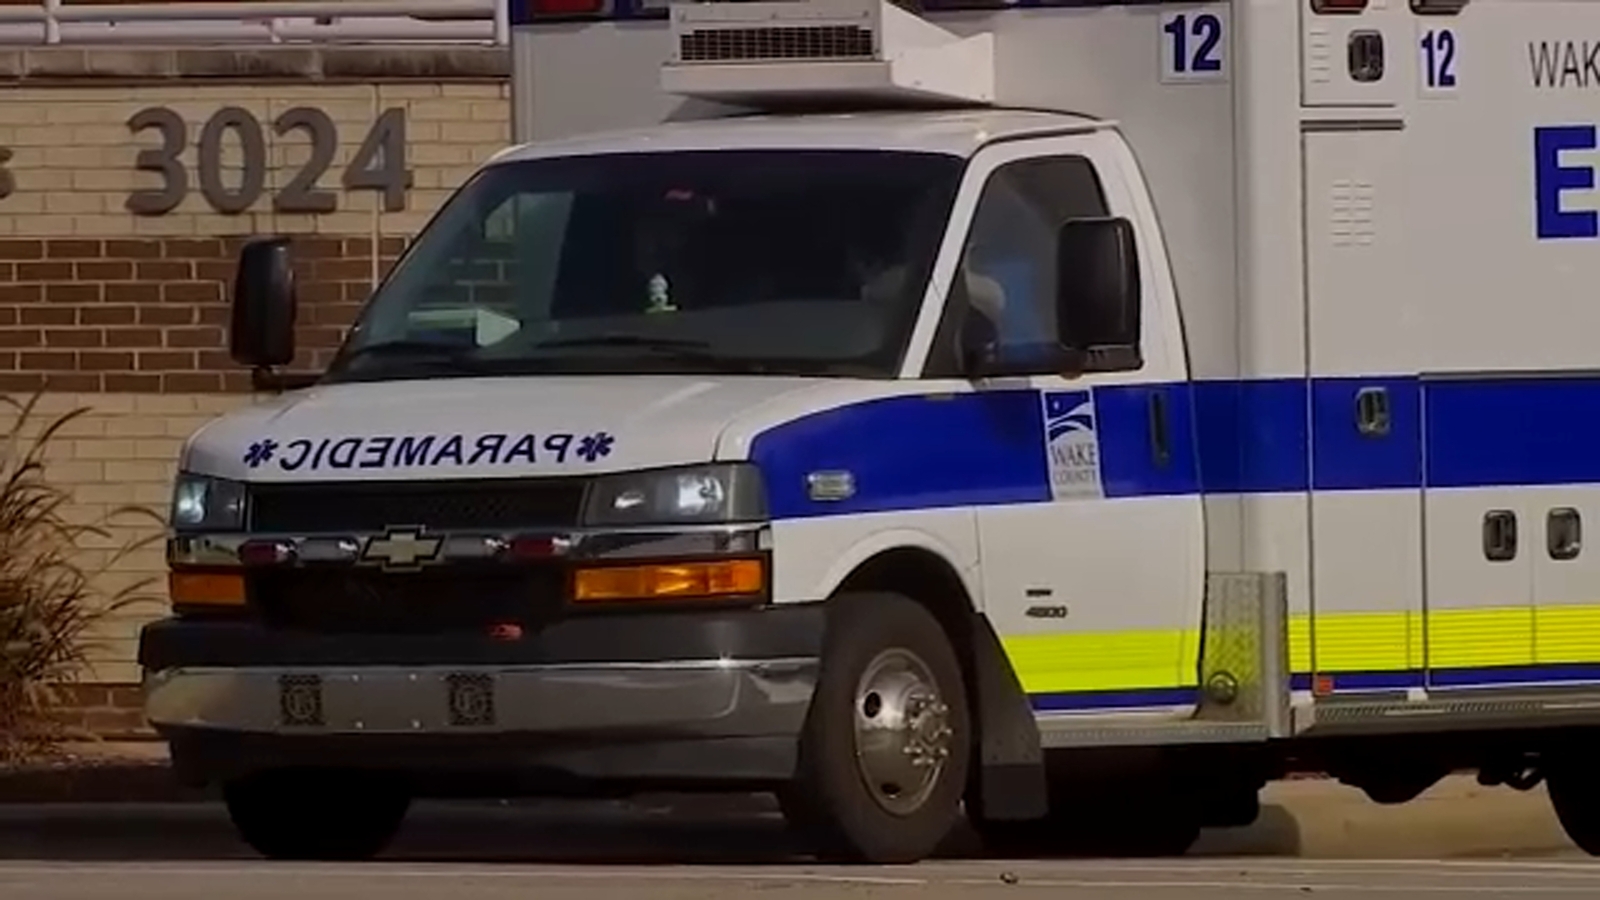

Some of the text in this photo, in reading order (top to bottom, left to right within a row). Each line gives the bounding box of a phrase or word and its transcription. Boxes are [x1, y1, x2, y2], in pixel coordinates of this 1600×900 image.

[1164, 14, 1222, 72] 12
[1421, 30, 1456, 87] 12
[1529, 41, 1600, 87] WAK
[125, 107, 413, 216] 3024
[1534, 125, 1598, 238] E
[1050, 442, 1096, 467] WAKE
